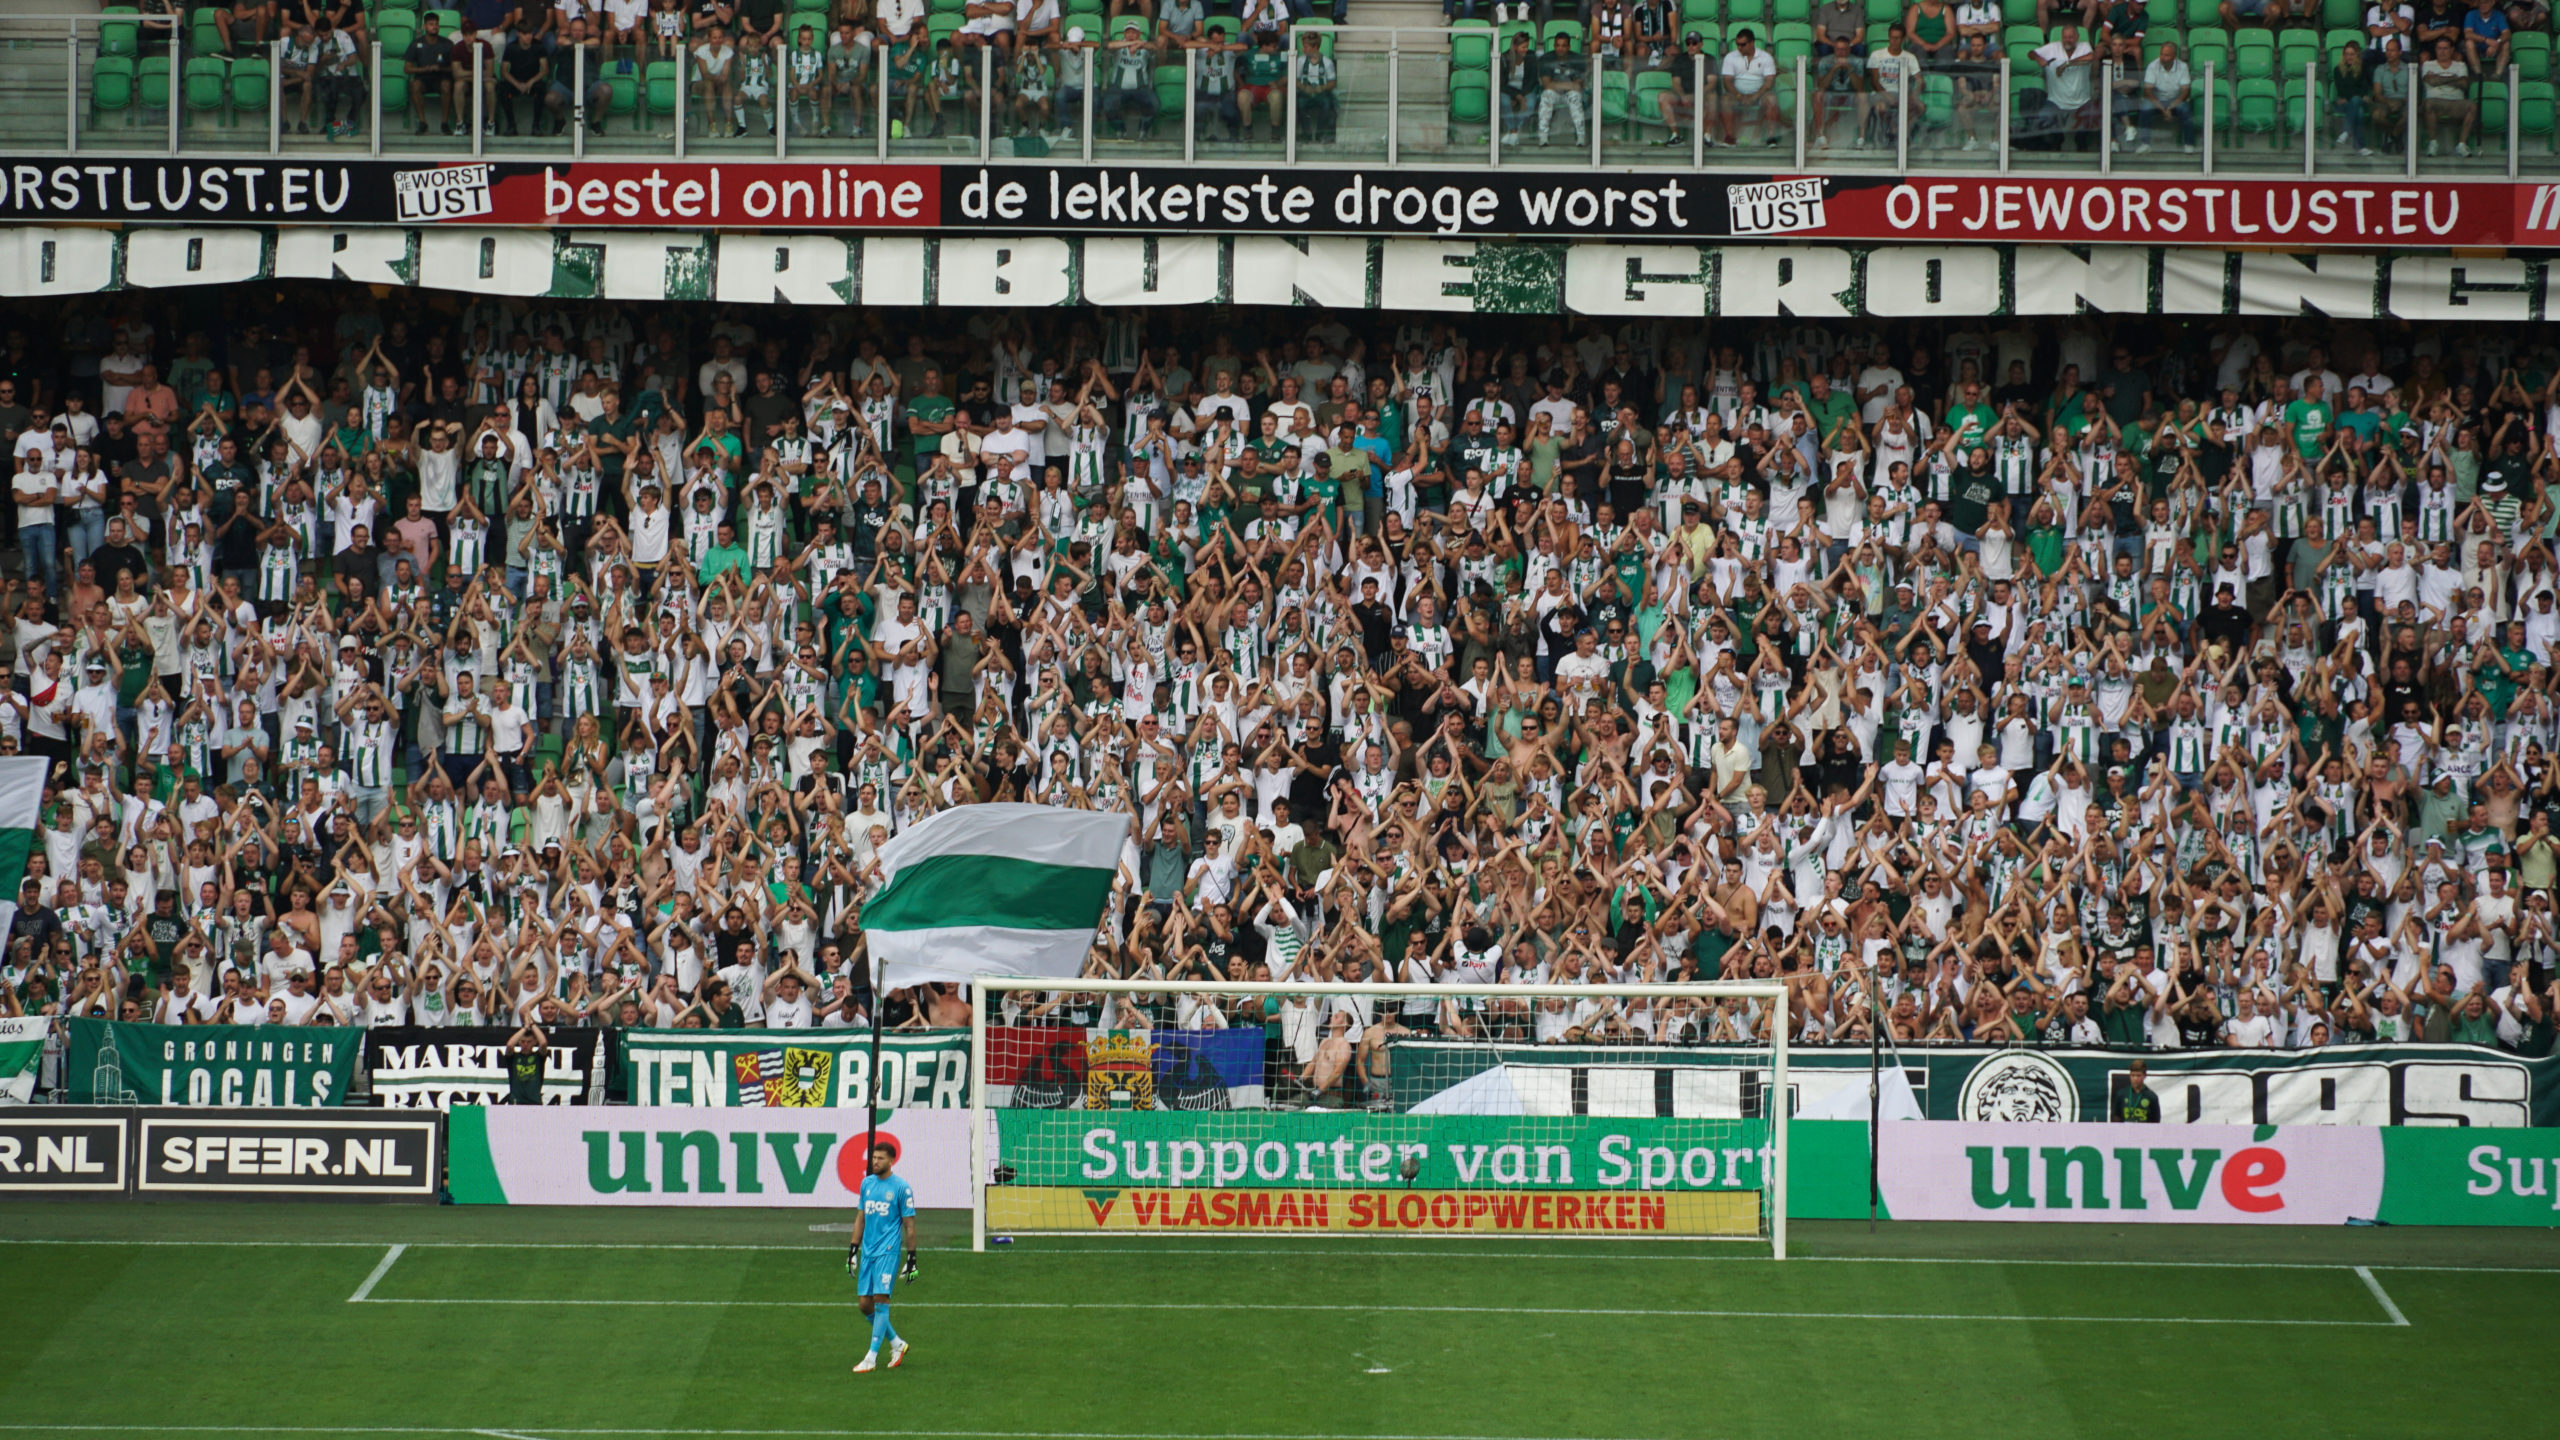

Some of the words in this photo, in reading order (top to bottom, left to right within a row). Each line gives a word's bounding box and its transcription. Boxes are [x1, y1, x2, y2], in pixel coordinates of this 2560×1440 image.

[0, 165, 349, 213] RSTLUST.EU
[412, 167, 485, 189] WORST
[545, 166, 720, 218] bestel
[743, 168, 923, 218] online
[1745, 180, 1819, 202] WORST
[399, 186, 486, 218] LUST
[961, 169, 1028, 219] de
[1049, 169, 1315, 224] lekkerste
[1335, 175, 1499, 234] droge
[1521, 176, 1689, 227] worst
[1732, 200, 1820, 231] LUST
[1885, 184, 2460, 236] OFJEWORSTLUST.EU
[1563, 243, 2560, 321] GRONING
[164, 1040, 333, 1064] GRONINGEN
[378, 1044, 578, 1071] MARTI
[161, 1067, 333, 1107] LOCALS
[629, 1048, 728, 1107] TEN
[837, 1049, 968, 1108] BOER
[161, 1136, 413, 1176] SFEER.NL
[1082, 1128, 1428, 1187] Supporter
[1448, 1144, 1574, 1184] van
[1597, 1133, 1775, 1190] Sport
[1965, 1125, 2286, 1213] univé
[1131, 1193, 1329, 1227] VLASMAN
[1347, 1194, 1665, 1230] SLOOPWERKEN
